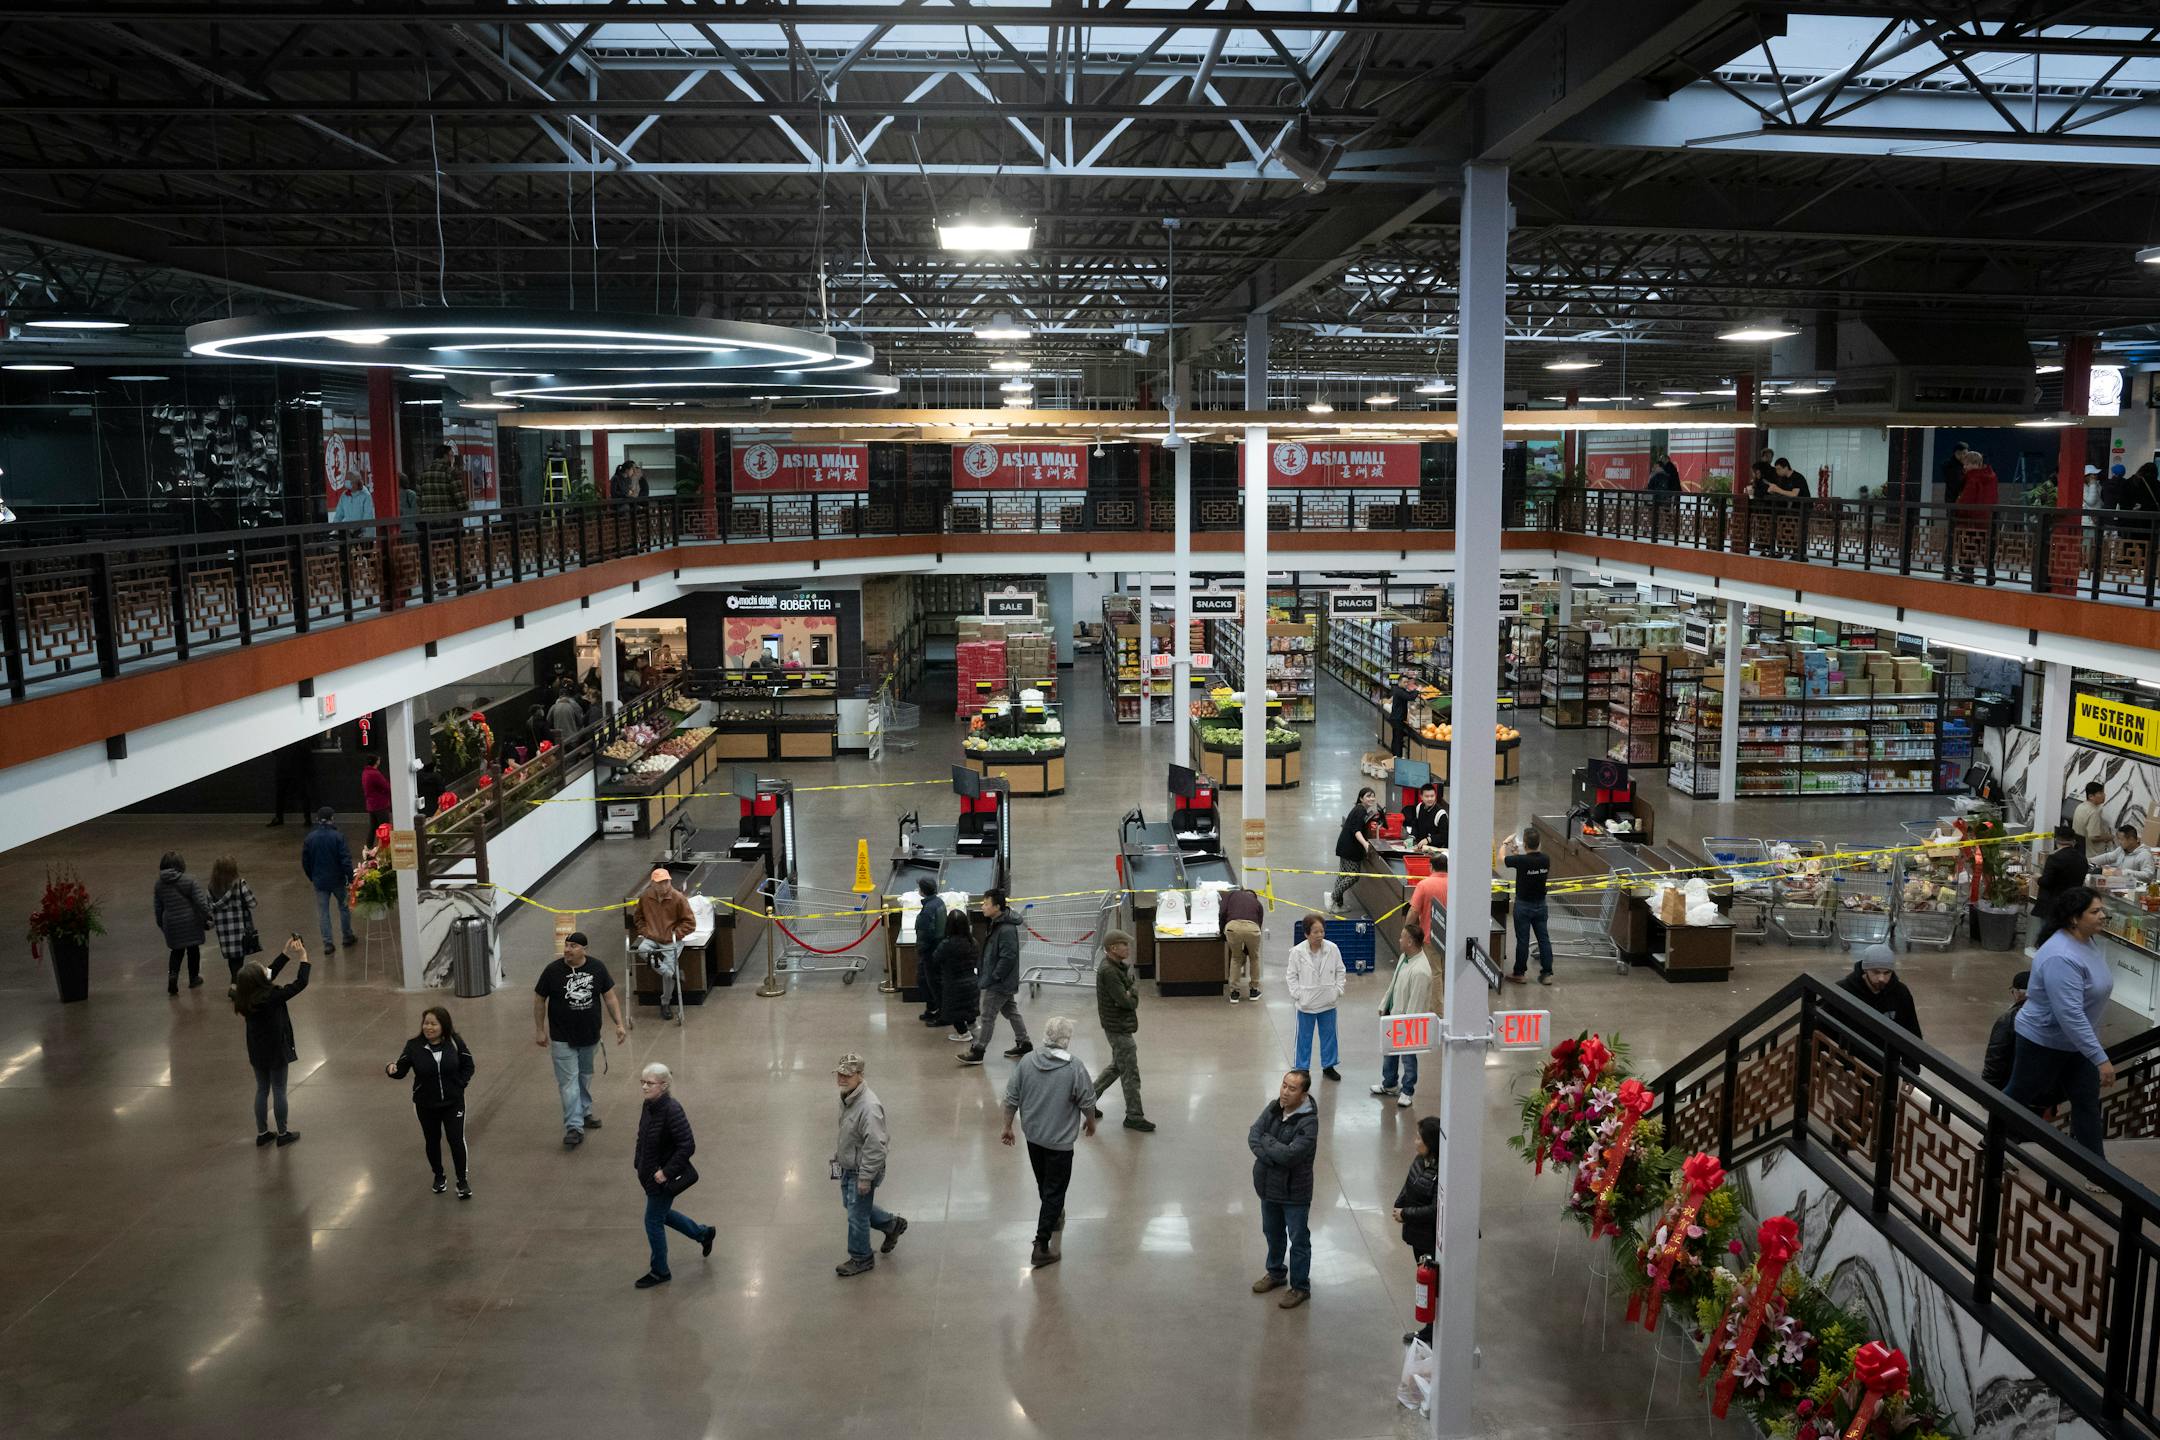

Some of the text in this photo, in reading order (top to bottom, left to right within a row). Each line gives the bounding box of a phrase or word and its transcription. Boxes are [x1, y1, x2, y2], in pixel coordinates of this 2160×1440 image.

[783, 454, 859, 468] ASIA MALL
[1002, 452, 1078, 468] ASIA MALL
[1311, 451, 1386, 465] ASIA MALL
[739, 595, 777, 607] mochi dough
[813, 599, 831, 610] TEA
[999, 603, 1023, 611] SALE
[1196, 600, 1232, 608] SNACKS
[1337, 599, 1373, 607] SNACKS
[1898, 635, 1922, 645] BEVERAGES
[1154, 655, 1168, 666] EXIT
[1196, 655, 1209, 665] EXIT
[2081, 703, 2145, 731] WESTERN
[2099, 722, 2144, 747] UNION
[1392, 1018, 1430, 1049] EXIT
[1503, 1014, 1542, 1044] EXIT
